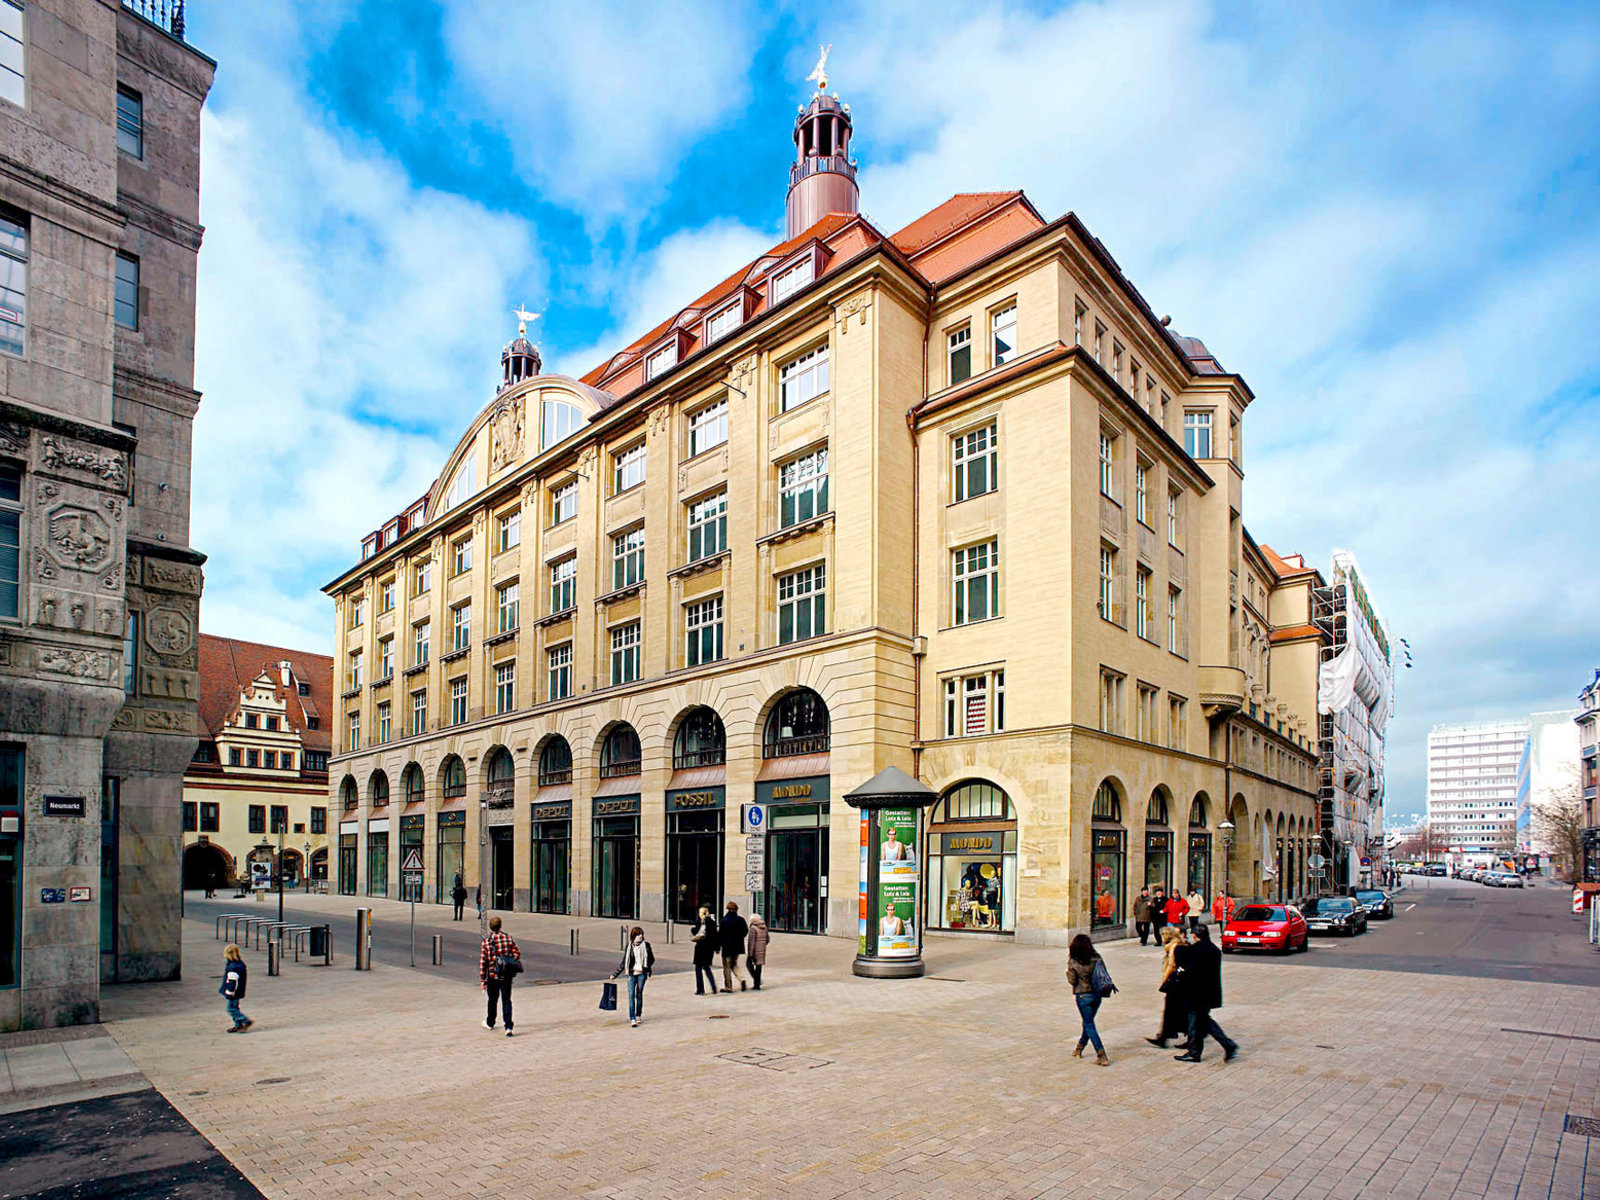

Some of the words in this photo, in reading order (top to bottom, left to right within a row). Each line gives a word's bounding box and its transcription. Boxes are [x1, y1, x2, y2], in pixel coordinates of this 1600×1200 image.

[673, 792, 716, 807] FOSSIL
[536, 805, 569, 817] DEPOT
[597, 800, 637, 813] DEPOT
